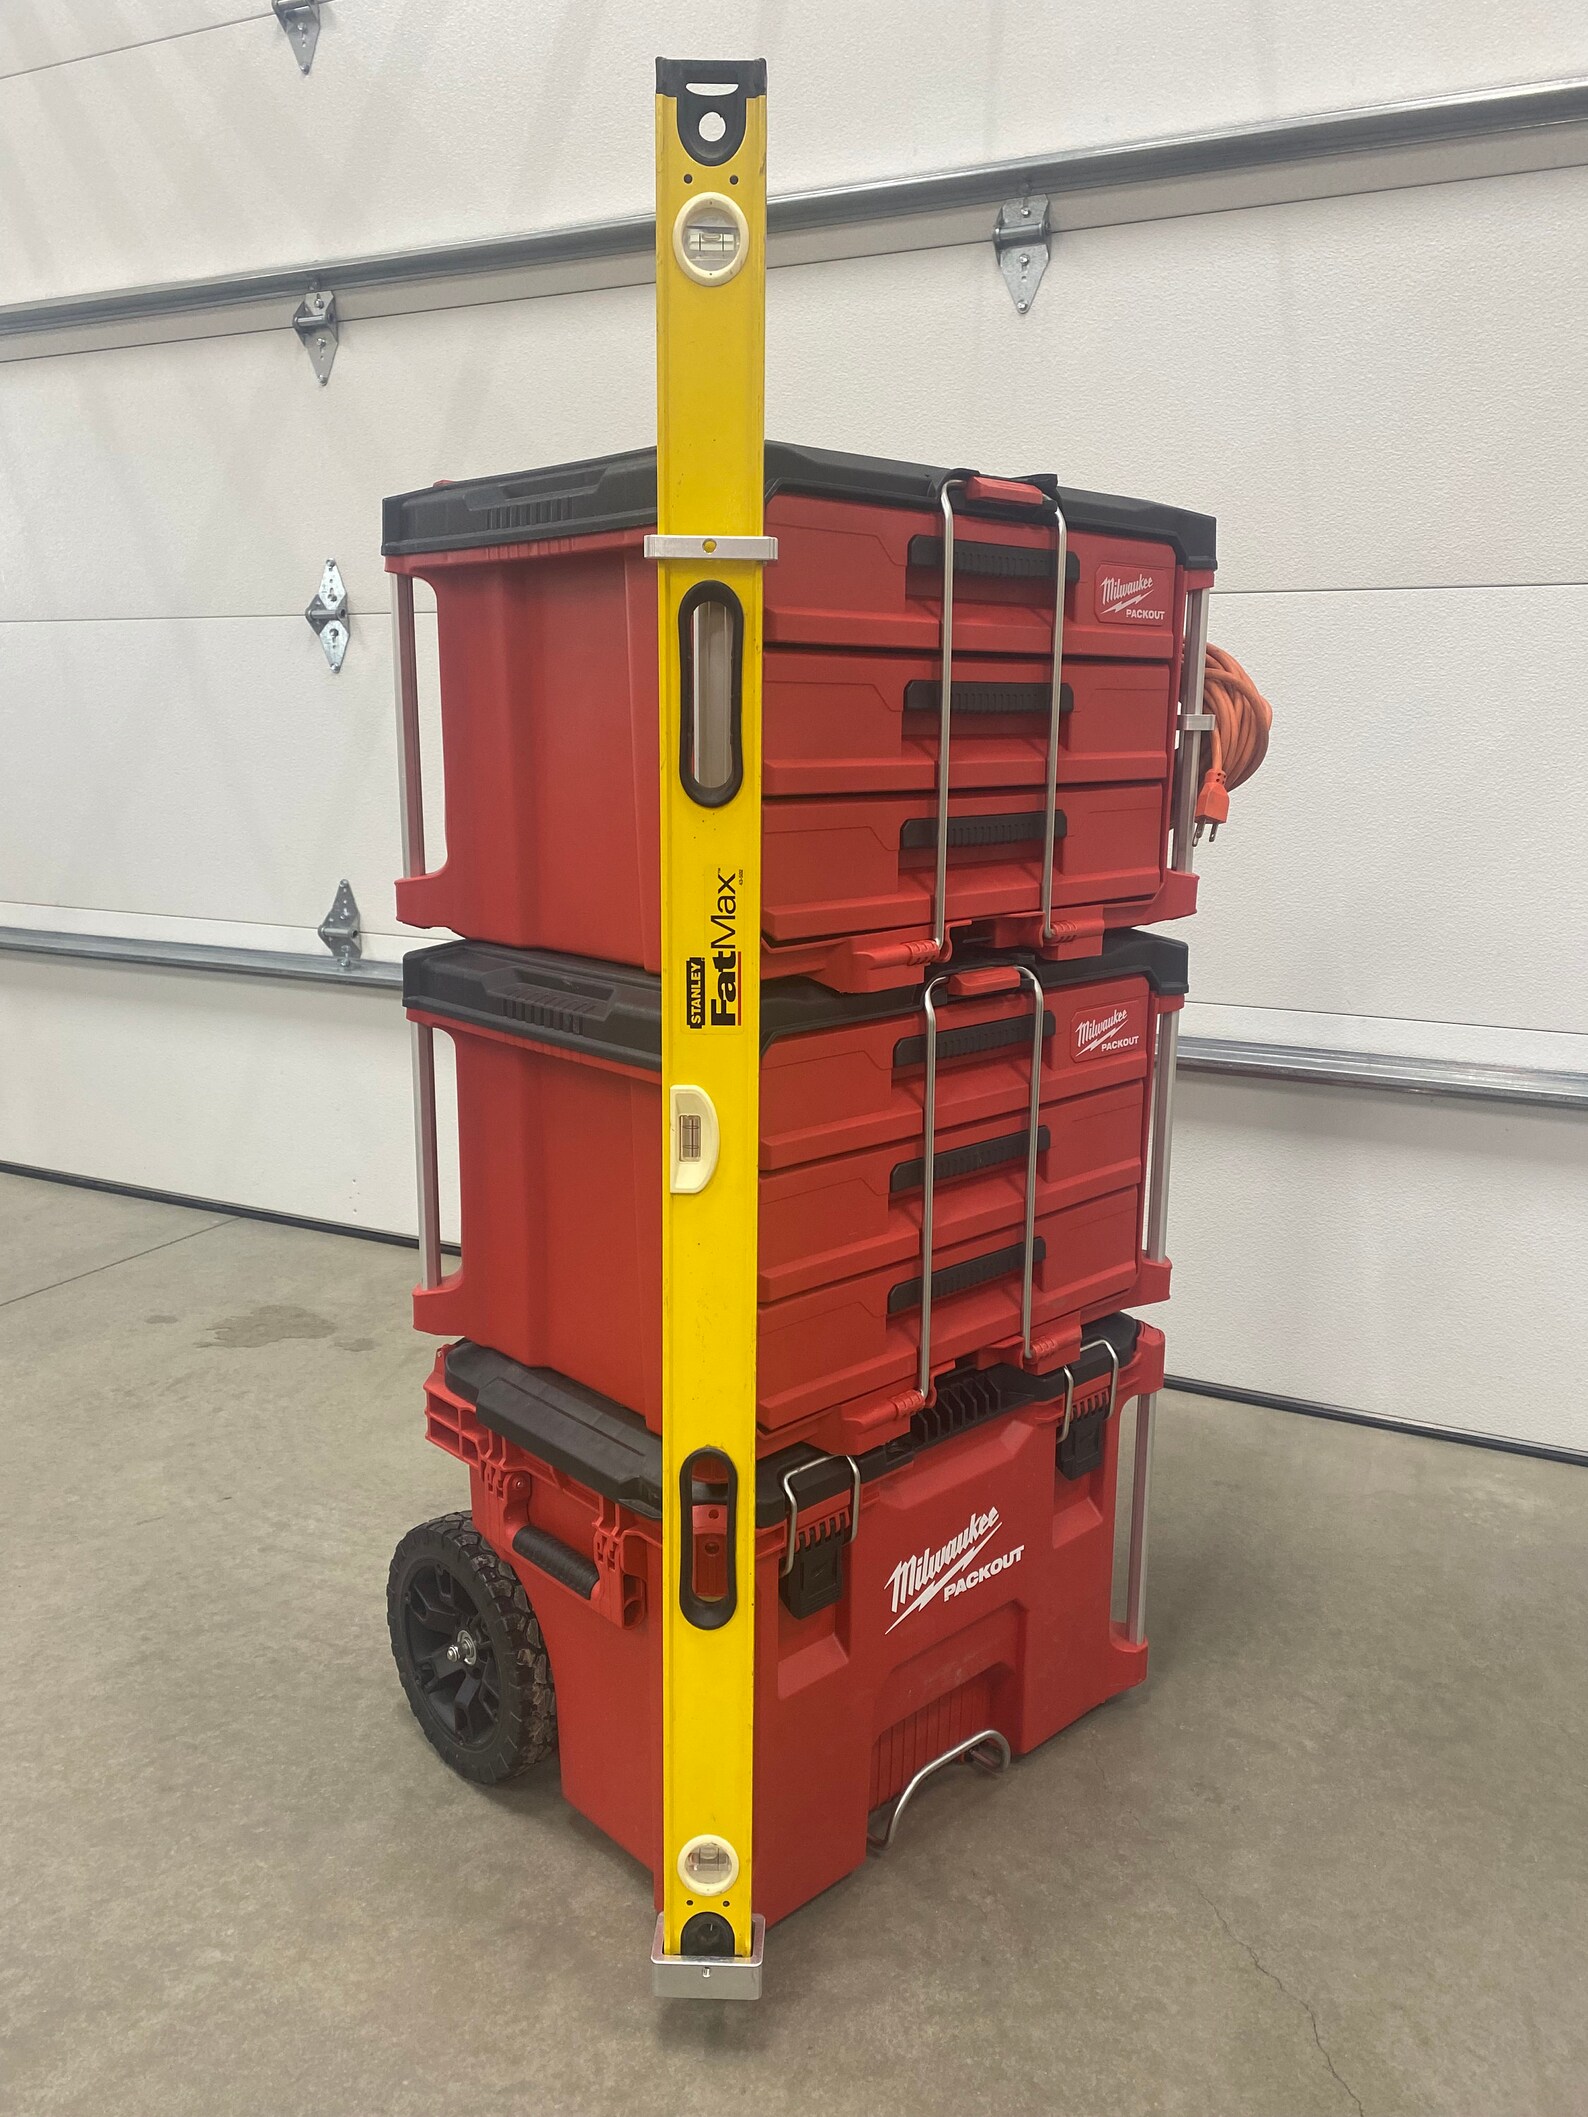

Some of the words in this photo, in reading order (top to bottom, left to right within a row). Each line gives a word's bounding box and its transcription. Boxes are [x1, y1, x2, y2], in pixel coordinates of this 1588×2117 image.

[1100, 573, 1153, 605] Milwaukee
[1126, 609, 1165, 620] PACKOUT
[711, 873, 736, 1026] FatMax
[691, 962, 701, 1023] STANLEY
[1075, 1009, 1127, 1047] Milwaukee
[1102, 1036, 1139, 1051] PACKOUT
[884, 1506, 999, 1613] Milwaukee
[944, 1545, 1024, 1602] PACKOUT
